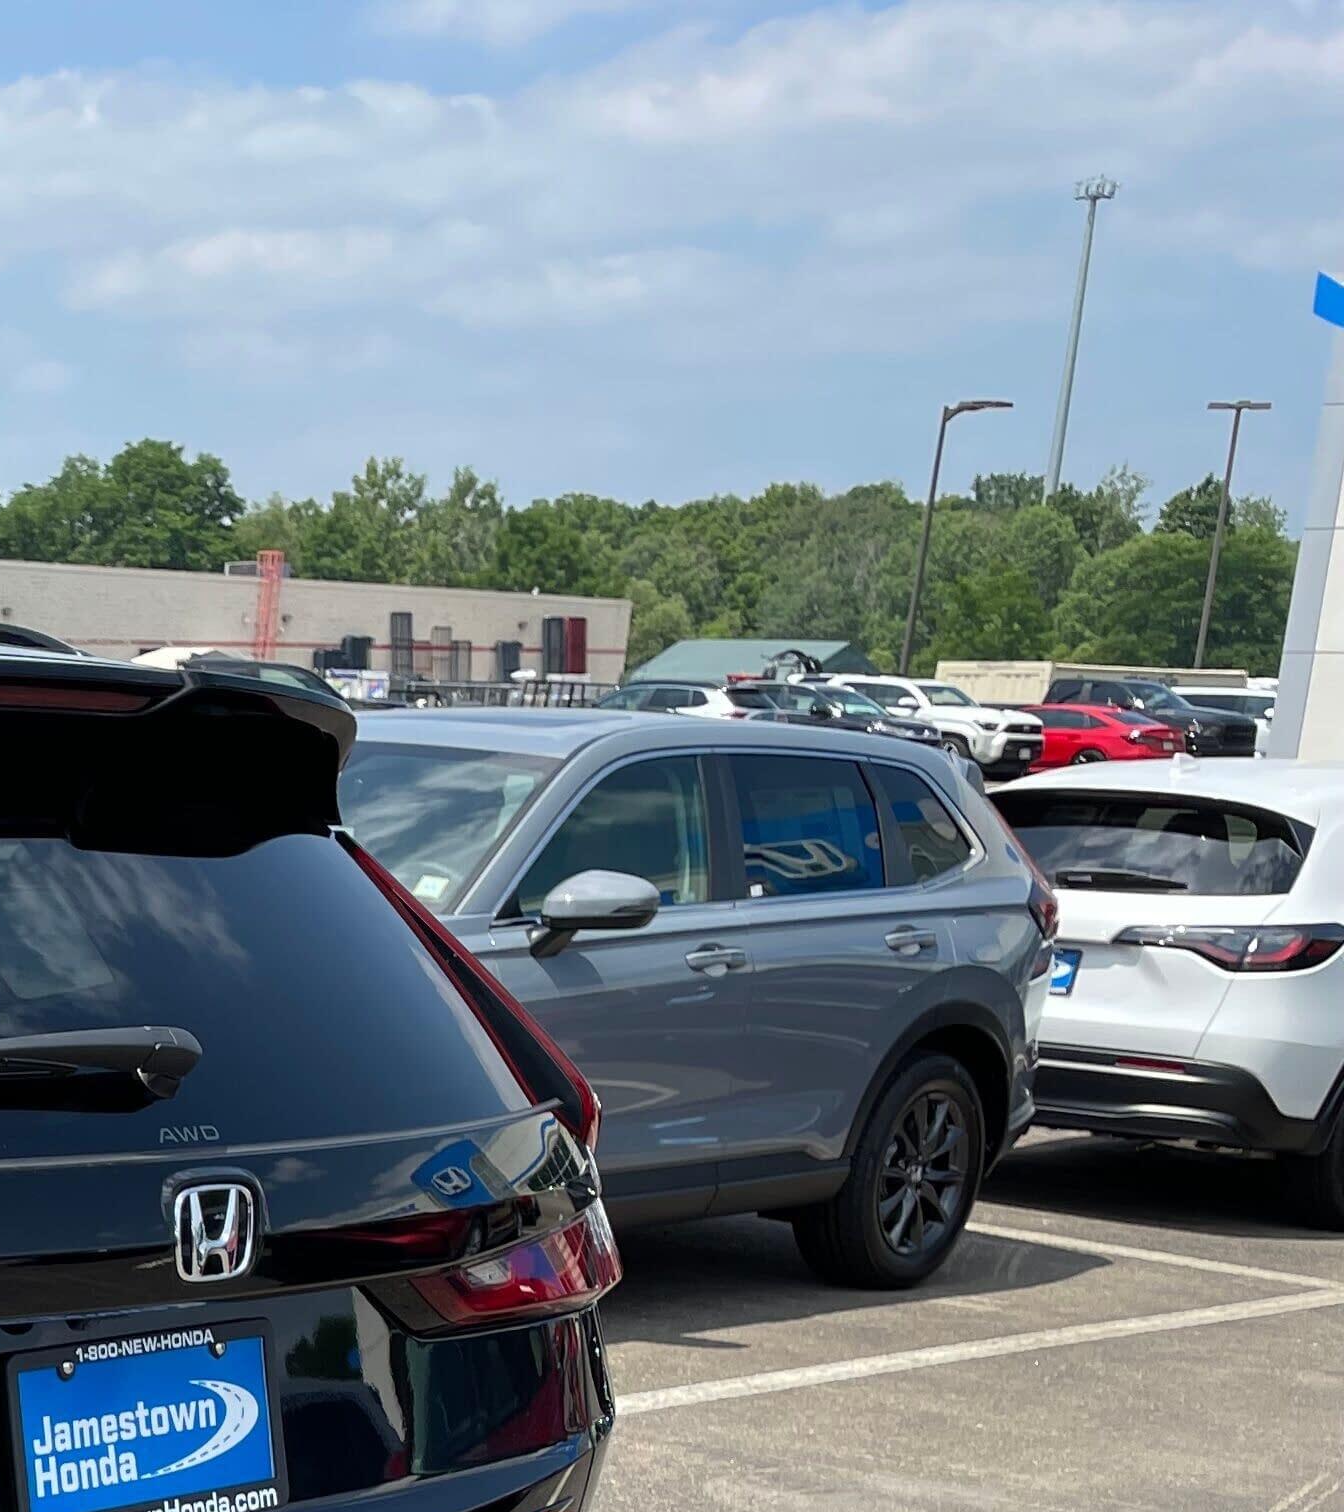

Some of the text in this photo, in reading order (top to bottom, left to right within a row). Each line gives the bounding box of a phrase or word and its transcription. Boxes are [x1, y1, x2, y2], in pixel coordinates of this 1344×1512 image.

[160, 1125, 220, 1143] AWD
[75, 1328, 215, 1363] 1-800-NEW-HONDA
[33, 1397, 217, 1456] Jamestown
[34, 1445, 138, 1498] Honda
